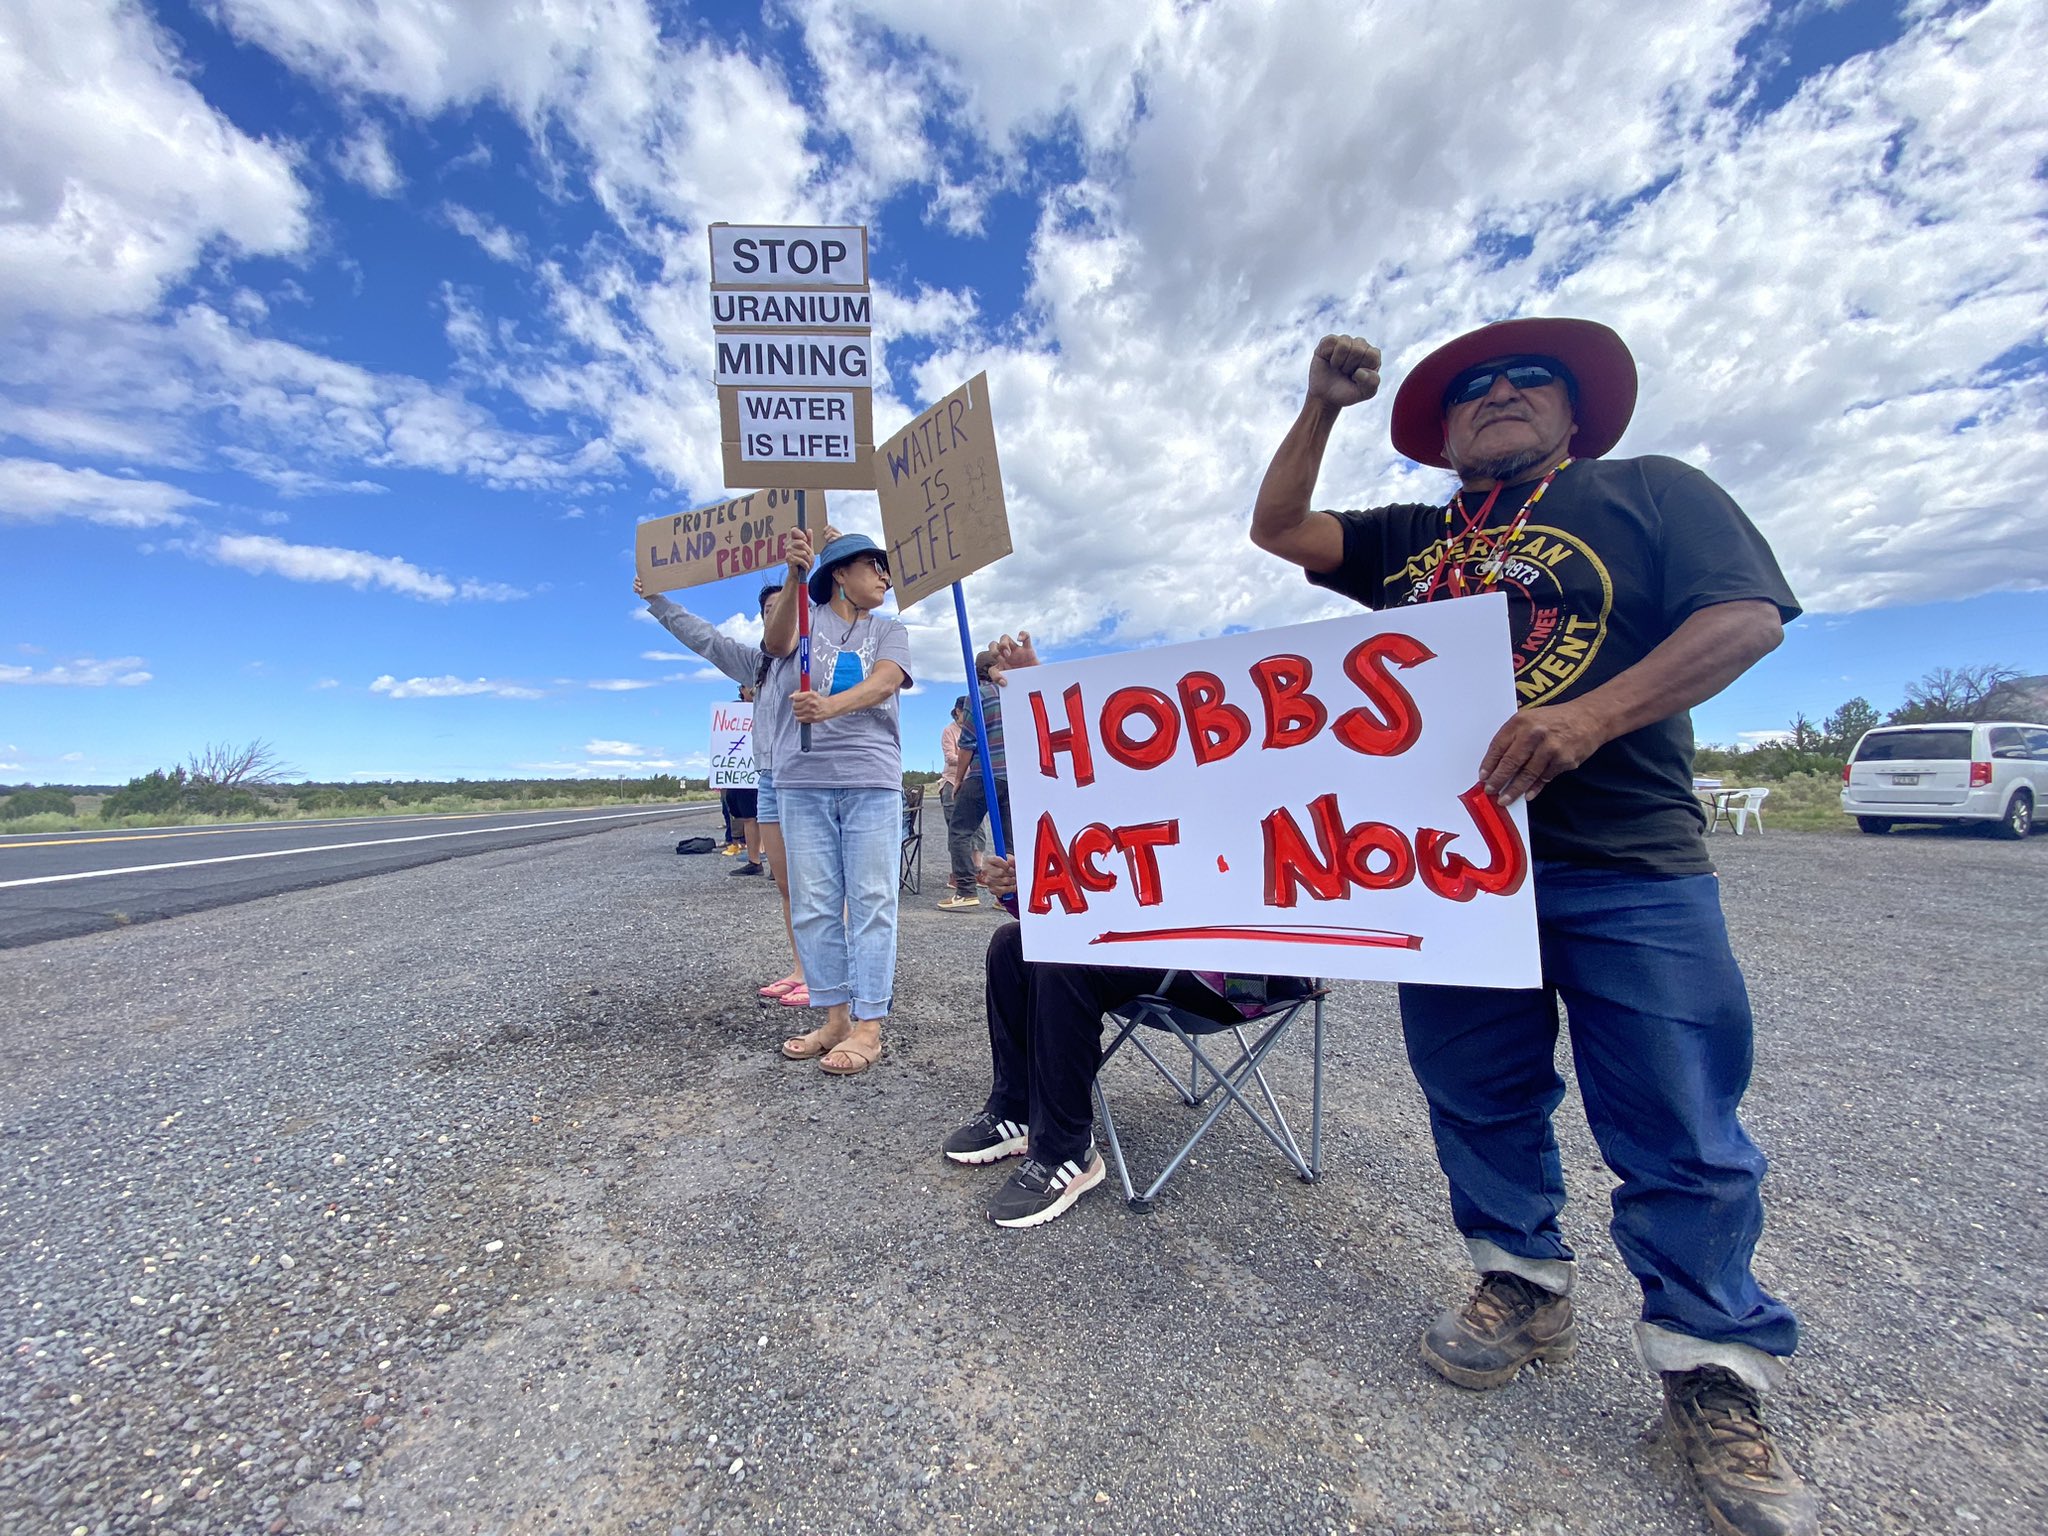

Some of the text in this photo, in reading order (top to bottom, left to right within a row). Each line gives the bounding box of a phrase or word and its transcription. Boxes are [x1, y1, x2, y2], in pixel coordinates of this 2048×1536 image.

[732, 237, 847, 275] STOP
[713, 294, 870, 323] URANIUM
[718, 342, 867, 377] MINING
[745, 396, 846, 421] WATER
[747, 433, 849, 457] IS LIFE!
[886, 399, 968, 488] WATER
[921, 468, 950, 512] IS
[673, 494, 755, 535] PROTECT
[651, 531, 716, 568] LAND
[740, 515, 774, 545] OUR
[716, 532, 788, 578] PEOPLE
[895, 502, 961, 587] LIFE
[1521, 607, 1558, 652] KNEE
[1028, 632, 1438, 788] HOBBS
[1028, 781, 1528, 915] ACT NOW
